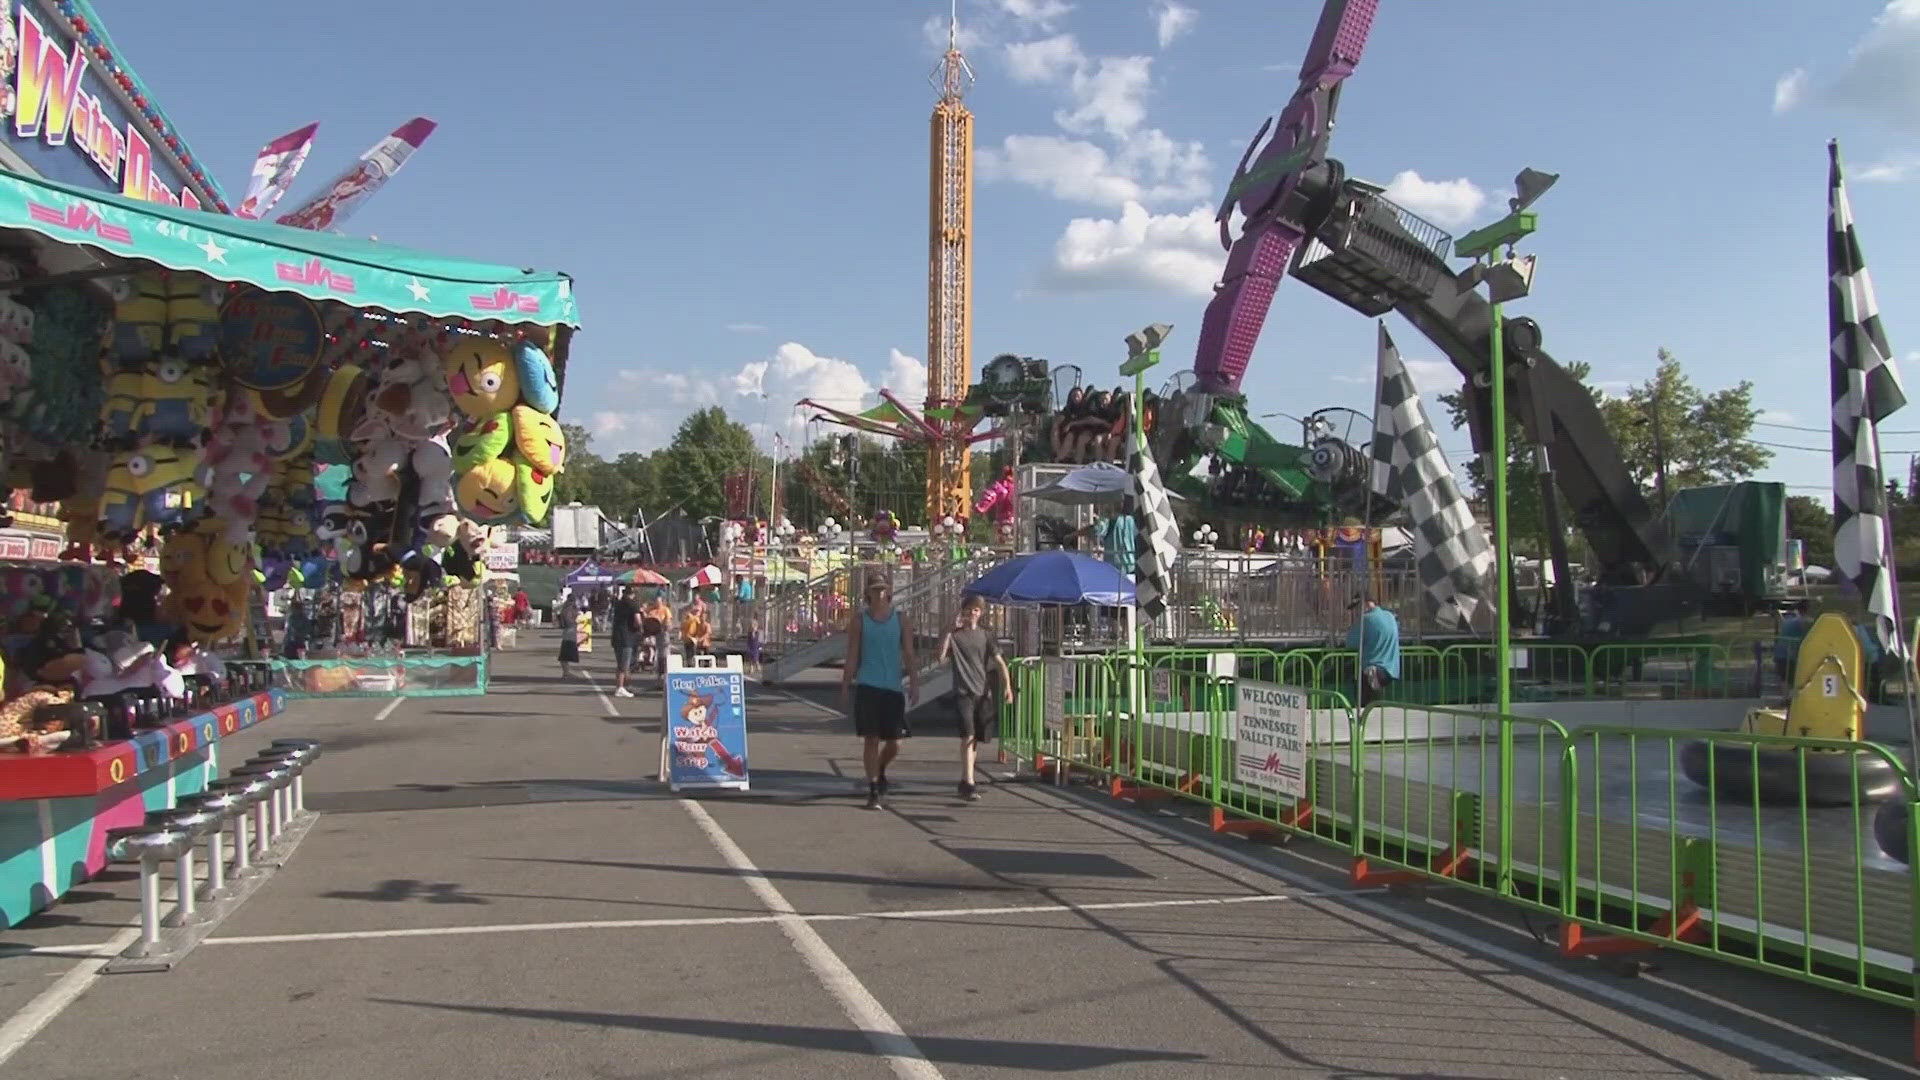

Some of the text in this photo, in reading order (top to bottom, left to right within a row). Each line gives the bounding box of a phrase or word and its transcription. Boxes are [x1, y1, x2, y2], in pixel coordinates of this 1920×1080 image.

[15, 4, 126, 183] Water
[1824, 677, 1833, 695] 5
[1242, 688, 1299, 710] WELCOME
[674, 726, 718, 740] Watch
[1242, 715, 1298, 737] TENNESSEE
[1239, 728, 1275, 748] VALLEY
